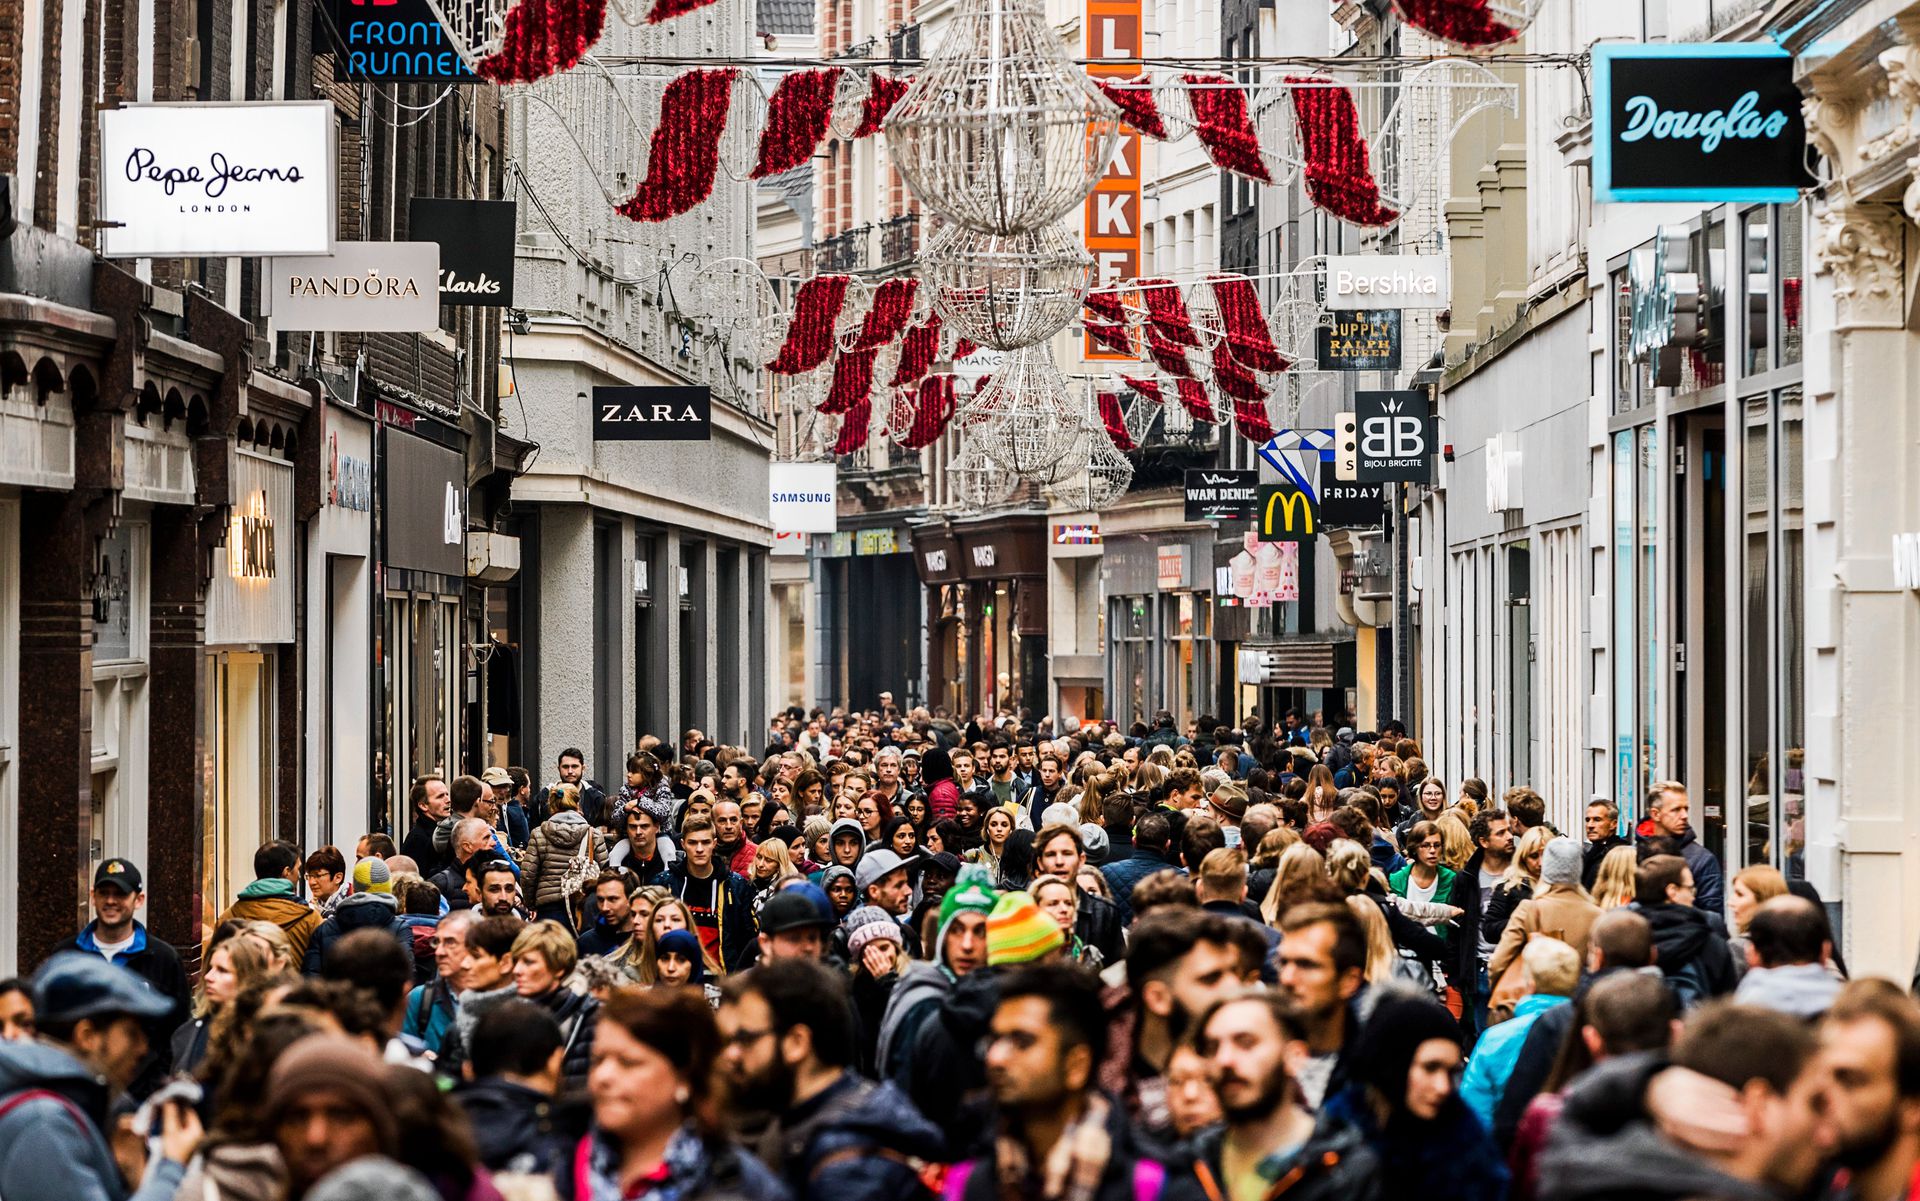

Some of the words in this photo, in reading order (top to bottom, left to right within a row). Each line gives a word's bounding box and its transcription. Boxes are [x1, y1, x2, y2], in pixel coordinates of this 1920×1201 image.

[350, 21, 443, 45] FRONT
[1620, 90, 1788, 153] Douglas
[126, 147, 204, 196] Pepe
[205, 152, 304, 198] Jeans
[180, 205, 251, 213] LONDON
[289, 276, 420, 297] PANDORA
[1336, 270, 1437, 294] Bershka
[1330, 340, 1390, 349] RALPH
[601, 404, 702, 422] ZARA
[1364, 460, 1386, 468] BIJOU
[1388, 459, 1422, 467] BRIGITTE
[772, 493, 831, 503] SAMSUNG
[1187, 488, 1217, 501] WAM
